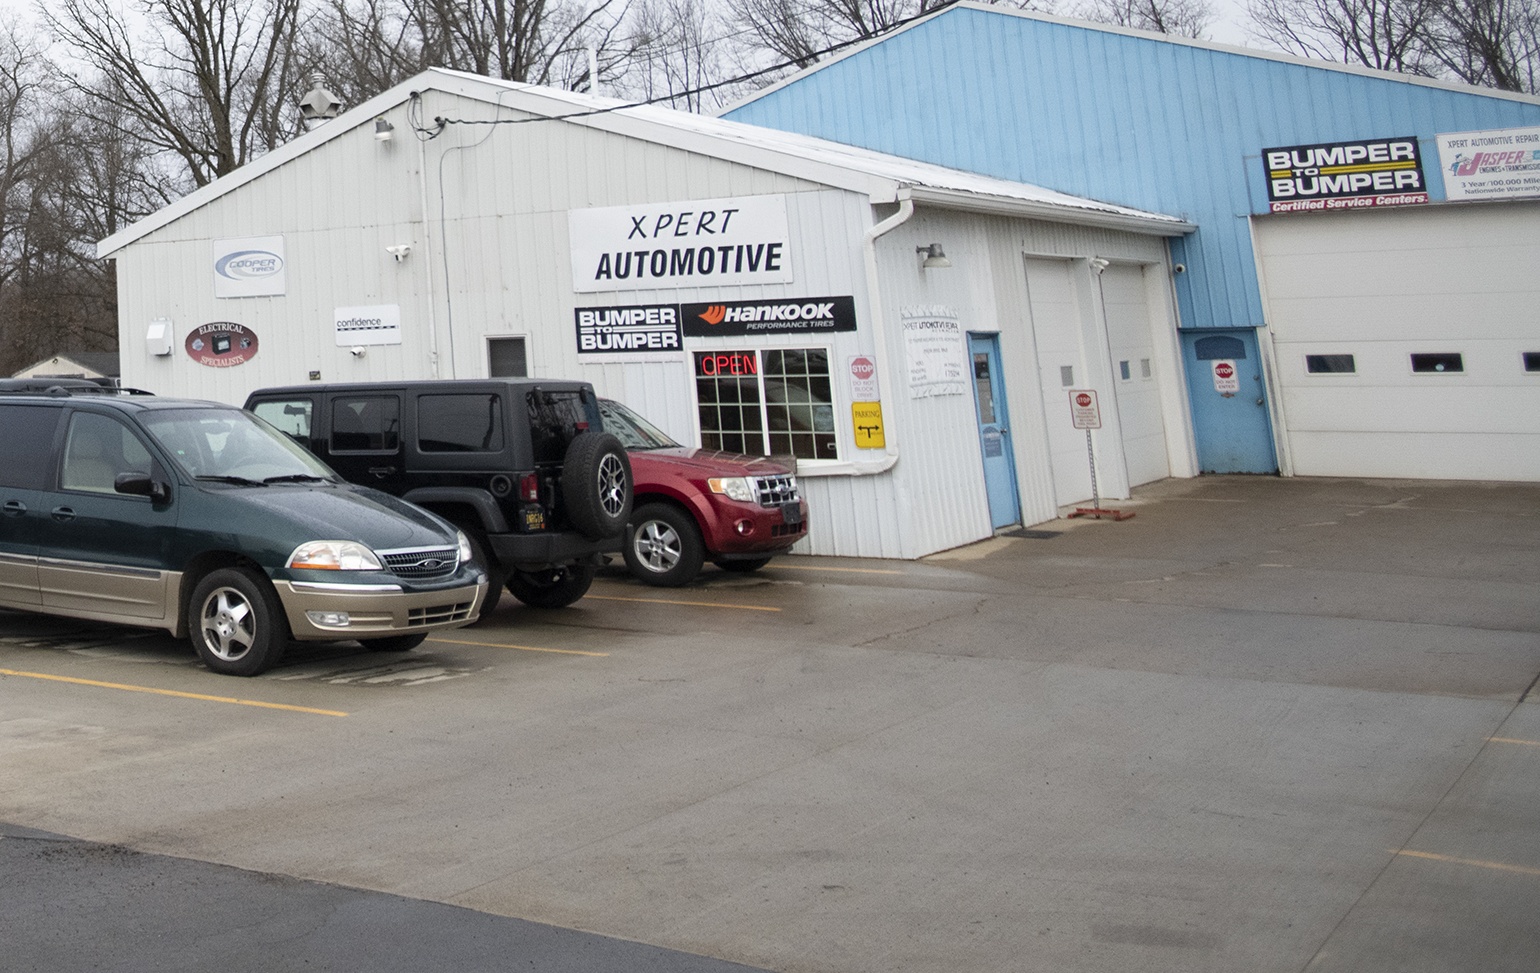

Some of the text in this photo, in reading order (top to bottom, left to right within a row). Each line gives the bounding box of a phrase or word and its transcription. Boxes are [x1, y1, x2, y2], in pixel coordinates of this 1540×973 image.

[1447, 134, 1540, 148] XPERT AUTOMOTIVE REPAIR
[1267, 142, 1416, 170] BUMPER
[1457, 150, 1525, 176] JASPER
[1479, 165, 1501, 173] ENGINES
[1292, 168, 1319, 176] TO
[1271, 170, 1421, 197] BUMPER
[1507, 185, 1540, 193] Warranty
[1272, 201, 1324, 212] Certified
[1326, 198, 1373, 208] Service
[628, 209, 740, 240] XPERT
[229, 259, 276, 269] COOPER
[595, 242, 784, 280] AUTOMOTIVE
[337, 318, 381, 327] confidence
[579, 308, 677, 326] BUMPER
[199, 322, 244, 335] ELECTRICAL
[594, 326, 613, 334] TO
[746, 320, 835, 330] PERFORMANCE TIRES
[581, 332, 679, 350] BUMPER
[200, 354, 245, 367] SPECIALISTS
[702, 355, 758, 375] OPEN
[852, 365, 874, 373] STOP
[855, 410, 880, 418] PARKING
